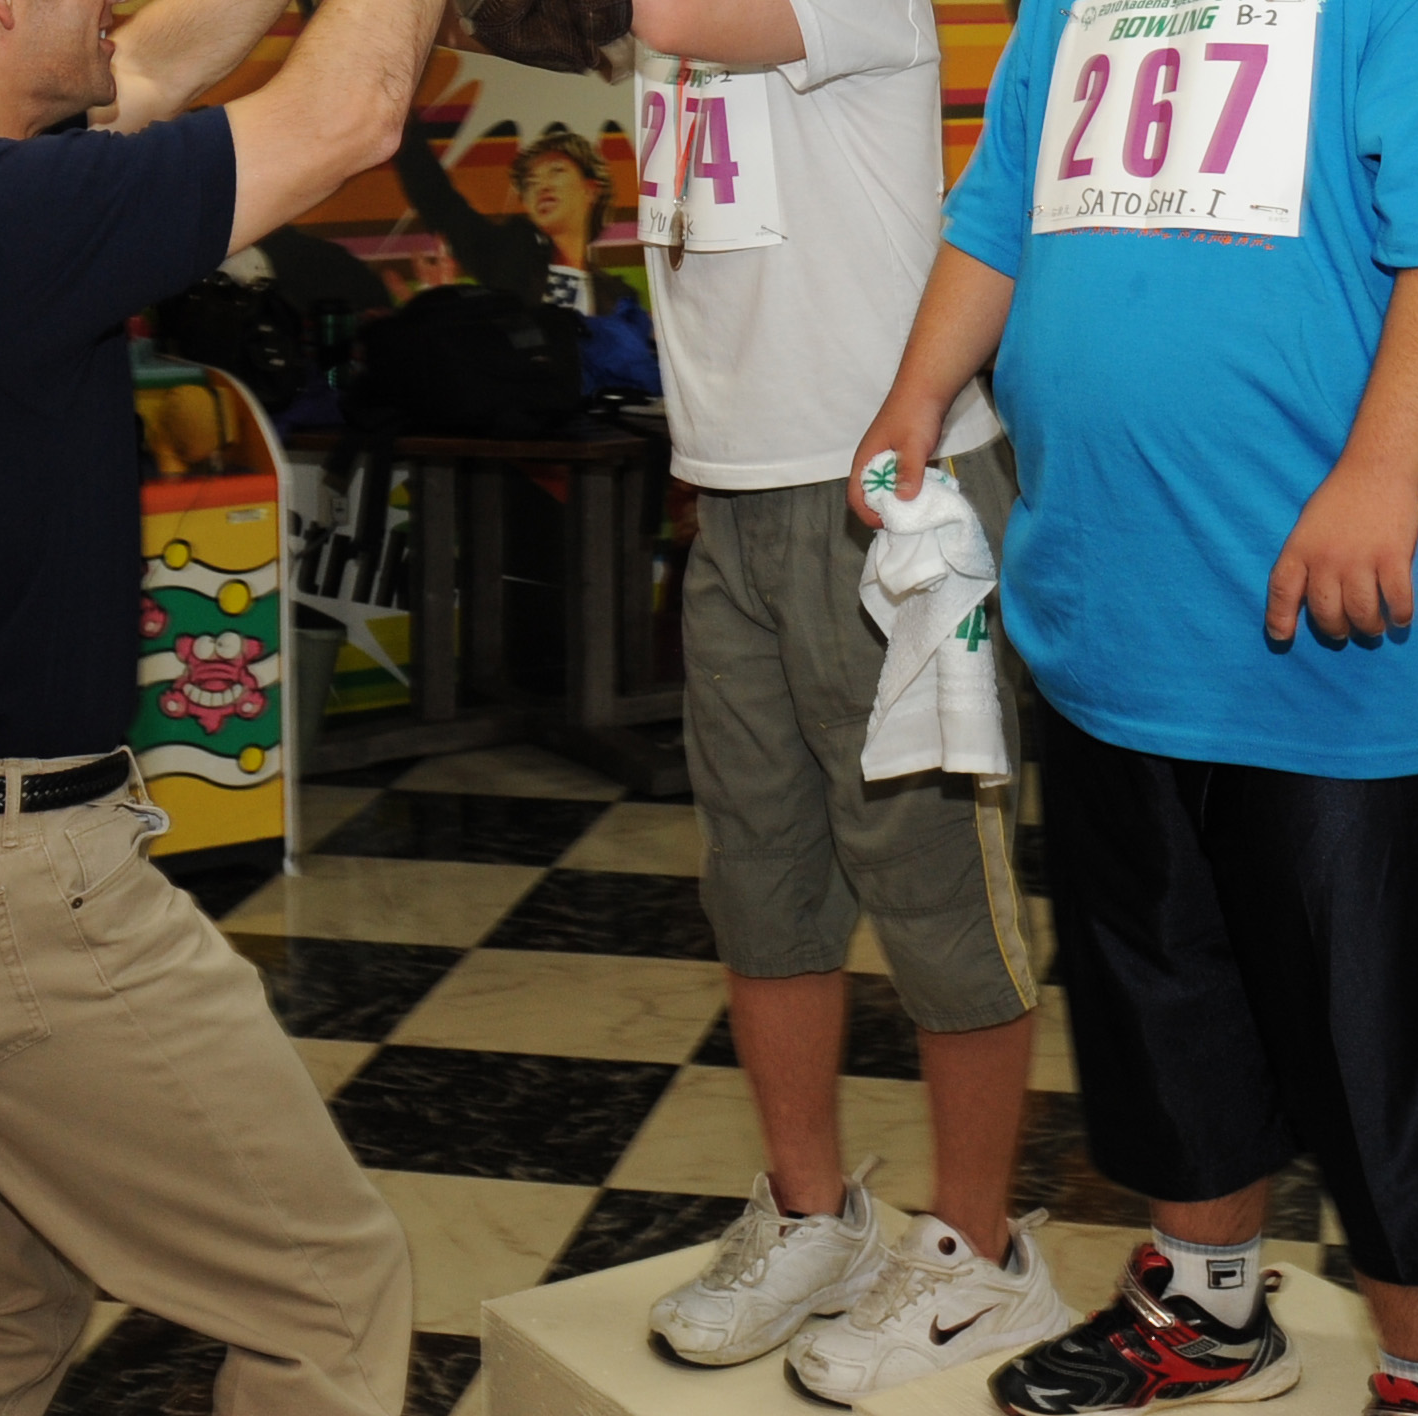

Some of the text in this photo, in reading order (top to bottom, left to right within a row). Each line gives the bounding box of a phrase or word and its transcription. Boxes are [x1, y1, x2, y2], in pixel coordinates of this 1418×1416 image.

[1108, 5, 1220, 42] BOWLING
[1236, 4, 1279, 27] B-2
[1056, 42, 1270, 181] 267
